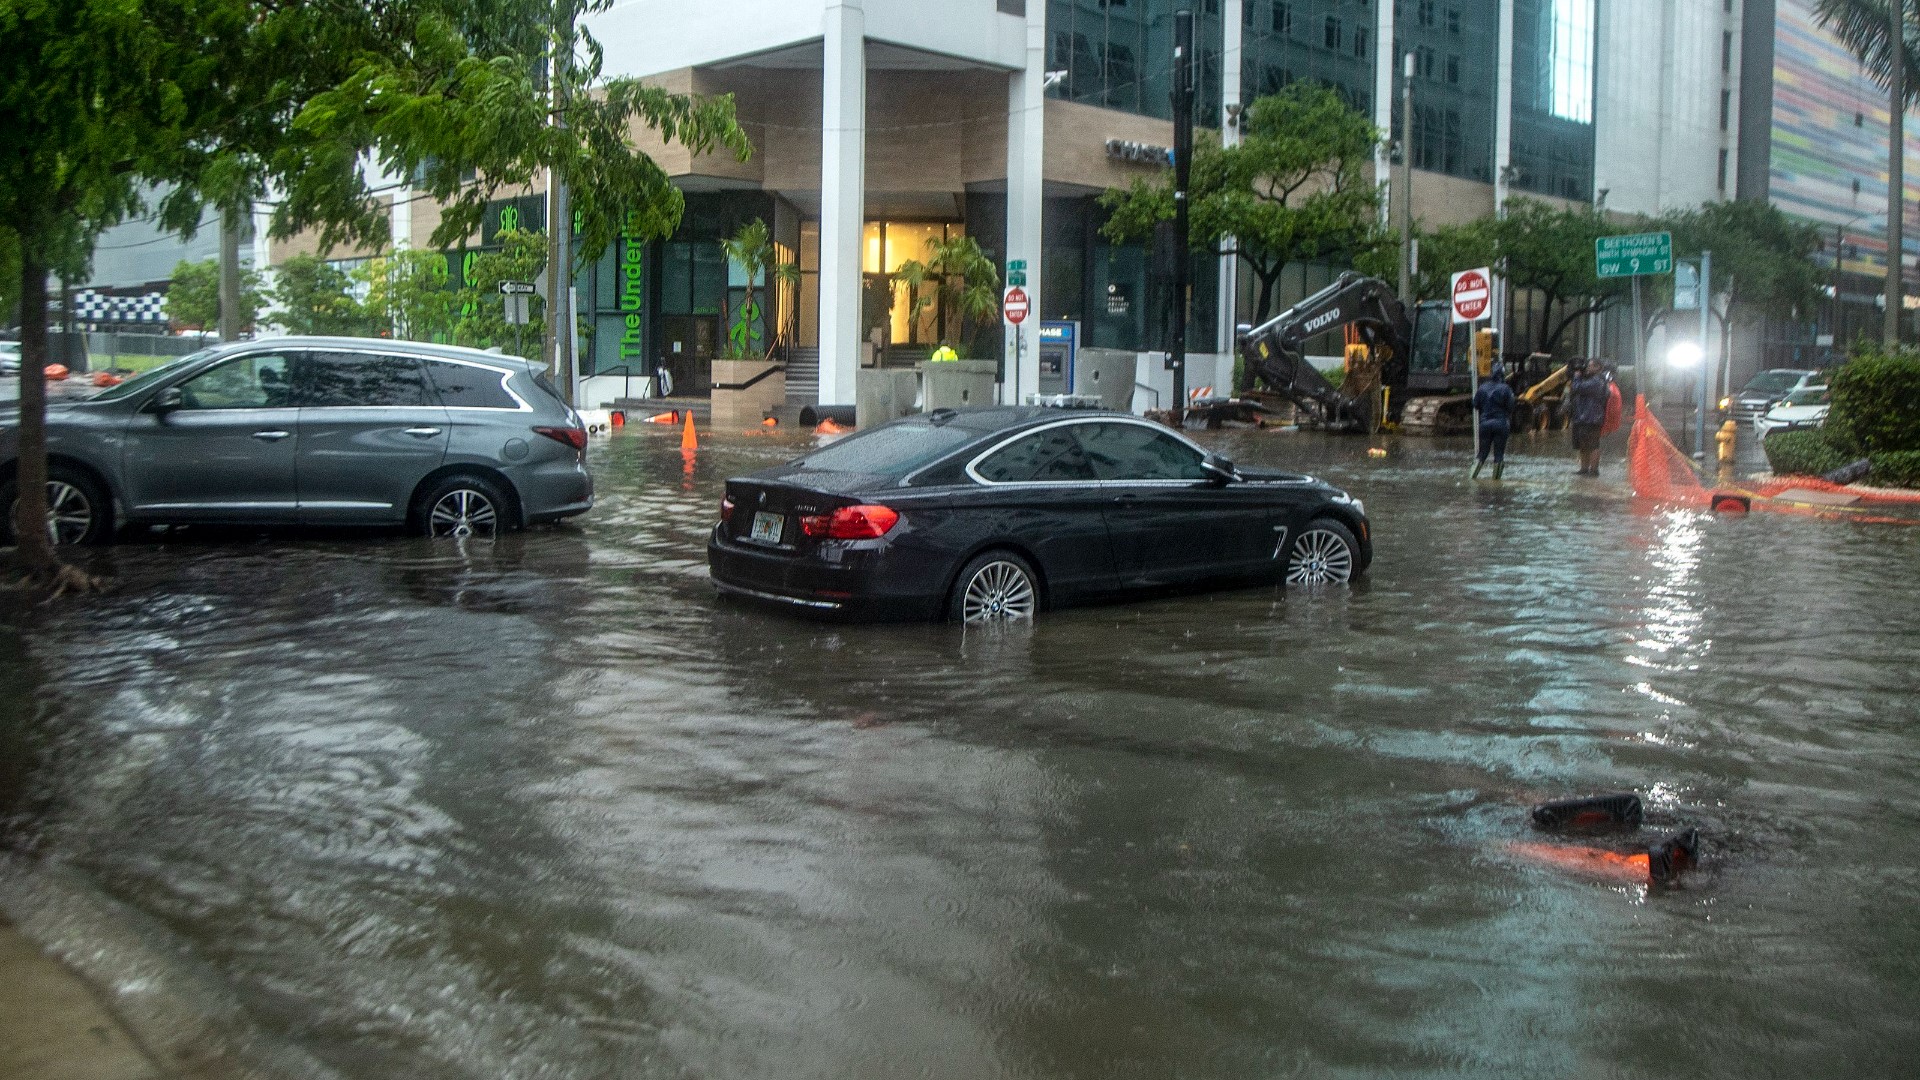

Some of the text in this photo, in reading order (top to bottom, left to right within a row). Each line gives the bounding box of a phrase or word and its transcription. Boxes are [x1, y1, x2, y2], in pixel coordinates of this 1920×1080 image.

[1105, 139, 1167, 162] CHASE
[1601, 257, 1668, 274] SW 9 ST
[1457, 278, 1482, 291] DO NOT
[1461, 300, 1482, 313] ENTER
[1304, 308, 1340, 332] VOLVO
[1039, 328, 1062, 337] HASE
